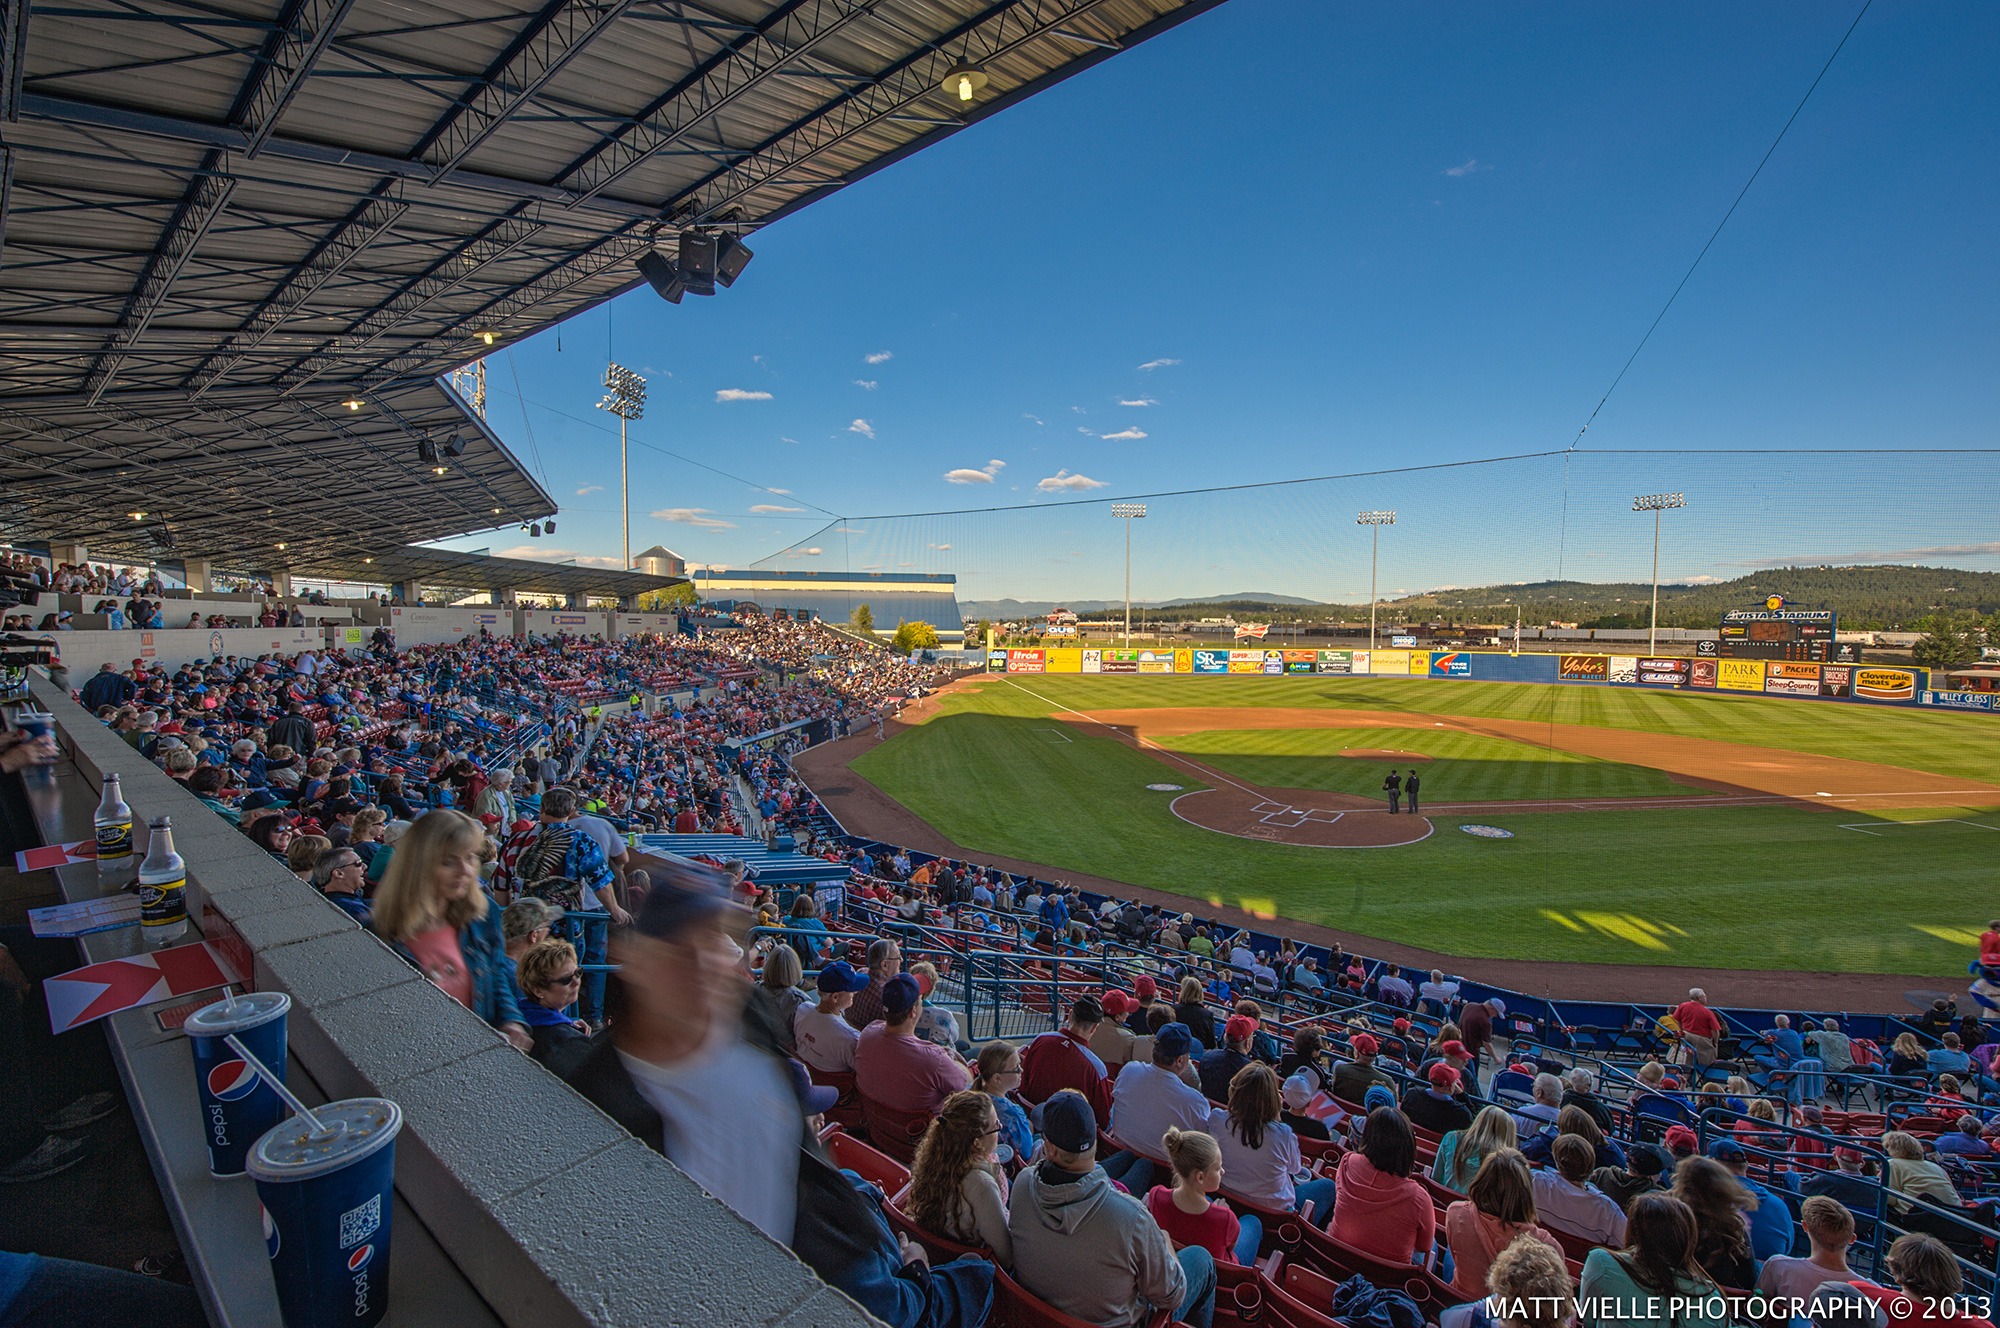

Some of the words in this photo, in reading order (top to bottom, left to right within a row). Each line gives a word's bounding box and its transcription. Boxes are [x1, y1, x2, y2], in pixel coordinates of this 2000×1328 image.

[1724, 609, 1768, 619] AVISTA
[1771, 609, 1830, 619] STADIUM
[1012, 650, 1039, 660] Itron
[1196, 651, 1216, 666] SR
[1563, 656, 1604, 676] Yoke's
[1724, 663, 1758, 675] PARK
[1785, 665, 1817, 674] PACIFIC
[1860, 672, 1910, 681] Cloverdale
[1767, 679, 1818, 690] SleepCountry
[209, 1104, 231, 1147] pepsi
[352, 1272, 371, 1318] pepsi
